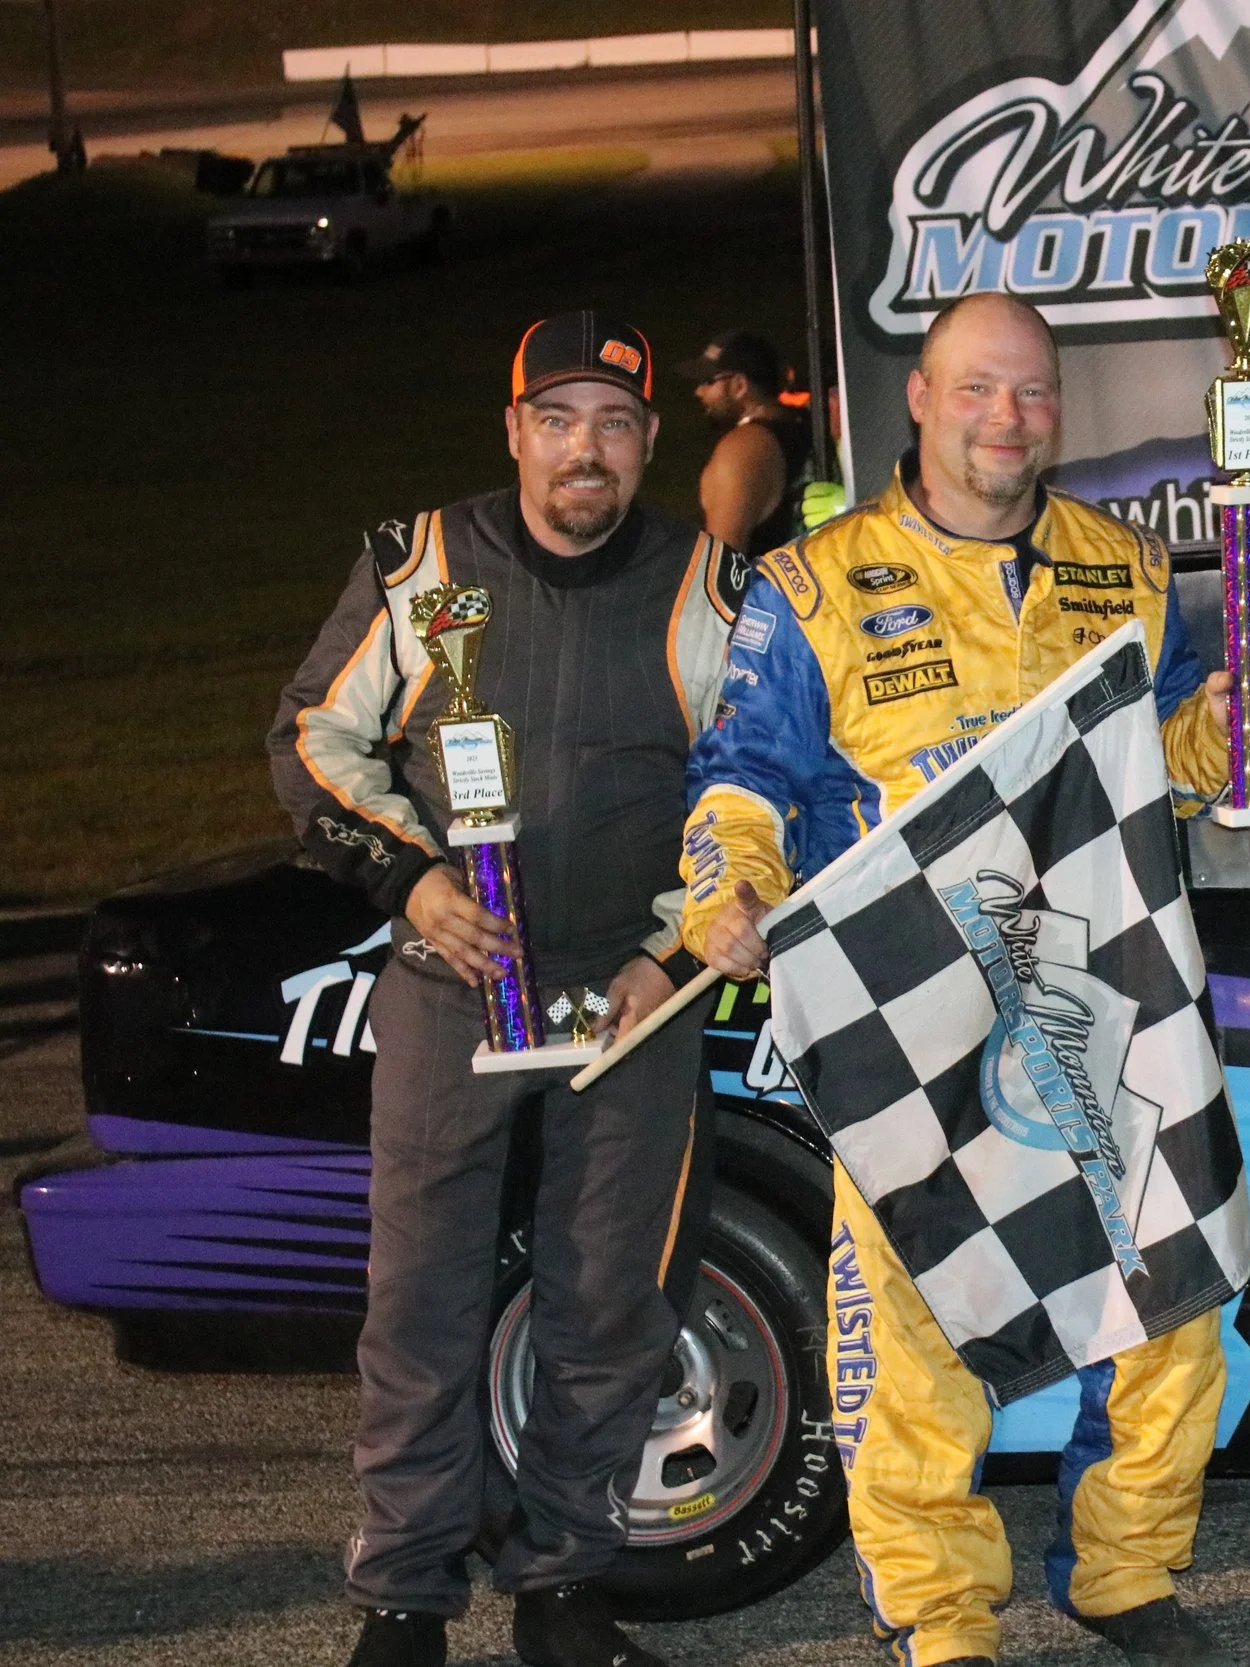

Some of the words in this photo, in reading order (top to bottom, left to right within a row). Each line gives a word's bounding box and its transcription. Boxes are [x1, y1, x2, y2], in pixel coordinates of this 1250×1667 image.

[1228, 450, 1242, 461] 1st
[869, 574, 895, 587] Sprint
[1057, 566, 1129, 584] STANLEY
[1058, 597, 1134, 620] Smithfield
[874, 609, 919, 634] Ford
[955, 714, 987, 730] True
[453, 789, 470, 801] 3rd
[473, 787, 503, 799] Place
[976, 868, 1040, 984] White
[1022, 984, 1126, 1180] Mountain
[1079, 1158, 1150, 1283] PARK
[830, 1218, 878, 1415] TWISTED
[673, 1495, 711, 1516] Bassett
